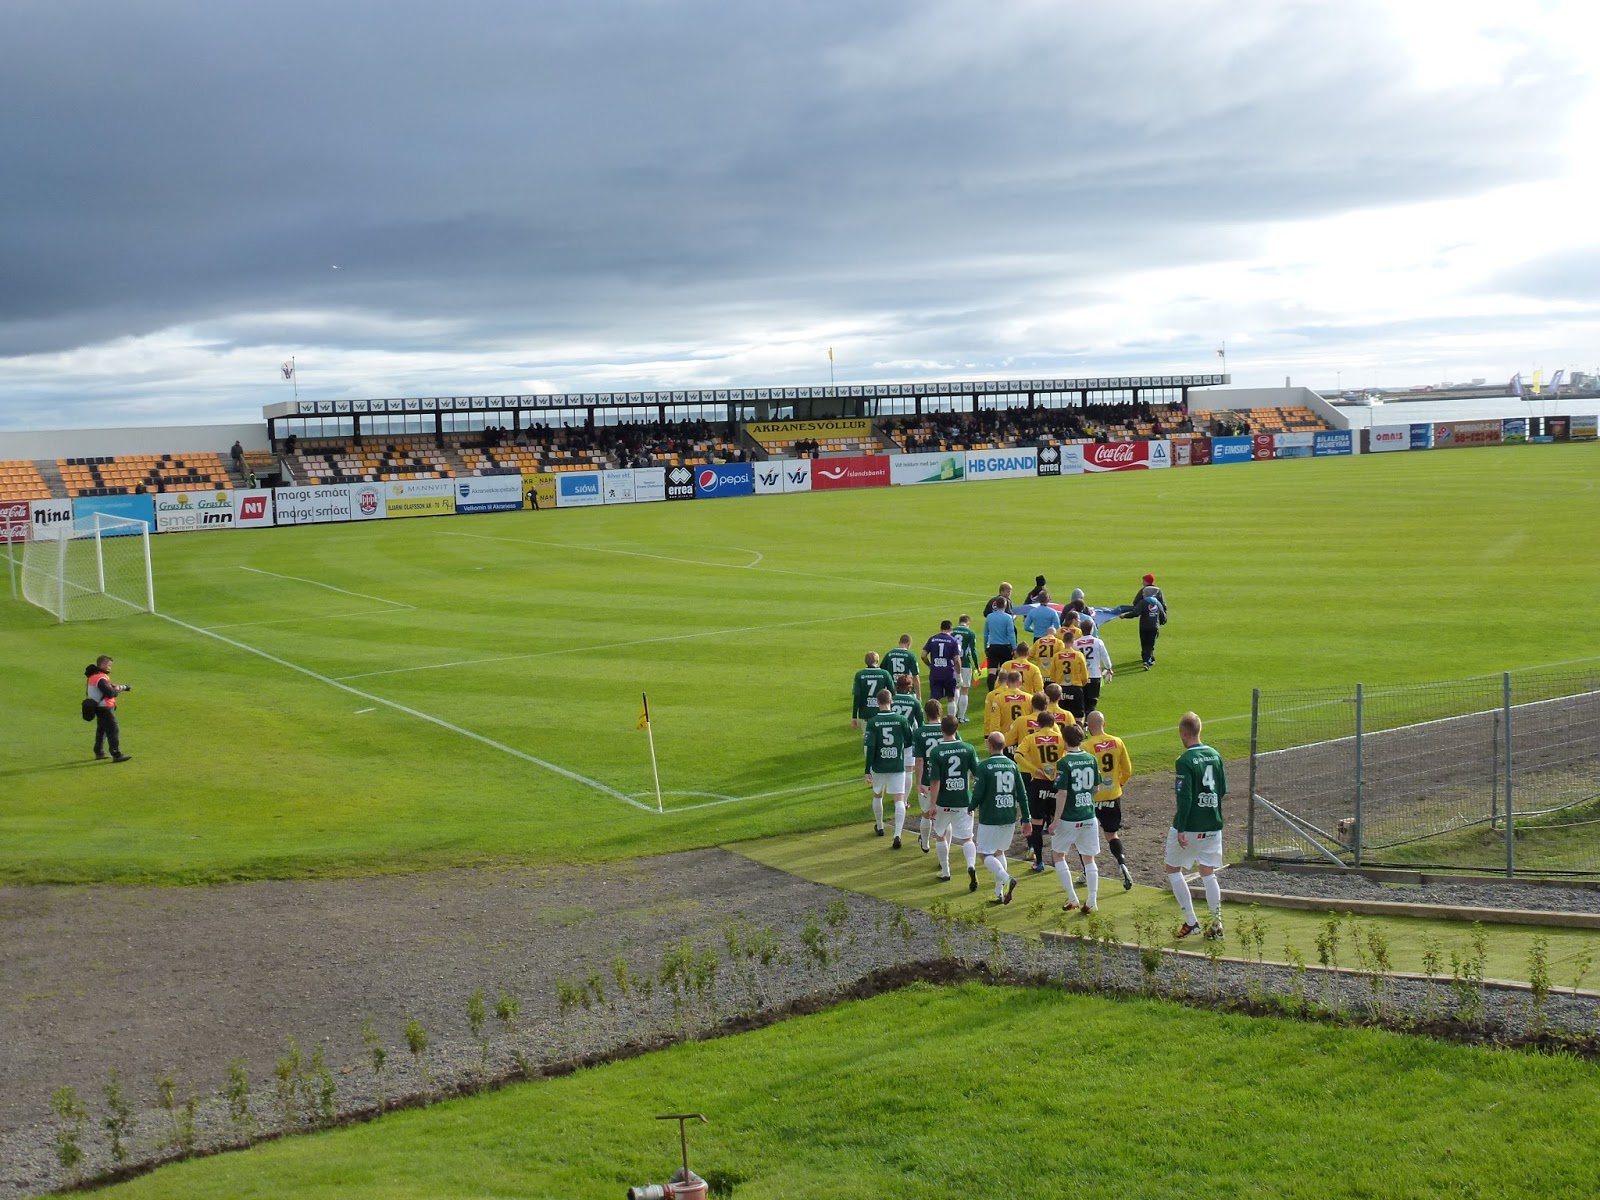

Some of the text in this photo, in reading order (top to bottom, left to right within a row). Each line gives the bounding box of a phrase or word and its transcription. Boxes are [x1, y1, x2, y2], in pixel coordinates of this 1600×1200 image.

[753, 421, 866, 432] AKRANESVÖLLUR
[1224, 444, 1250, 454] EIMSKIP
[720, 473, 749, 486] pepsi
[574, 484, 597, 494] SJÓVÁ
[244, 502, 262, 514] N1
[938, 642, 945, 658] 1
[1039, 645, 1054, 658] 21
[891, 658, 906, 673] 15
[1062, 661, 1072, 674] 3
[867, 680, 878, 696] 7
[1011, 705, 1022, 720] 6
[882, 727, 895, 746] 5
[1038, 744, 1058, 764] 16
[948, 756, 961, 776] 2
[1102, 753, 1114, 772] 9
[994, 771, 1015, 792] 19
[1071, 767, 1095, 792] 30
[1202, 765, 1216, 790] 4
